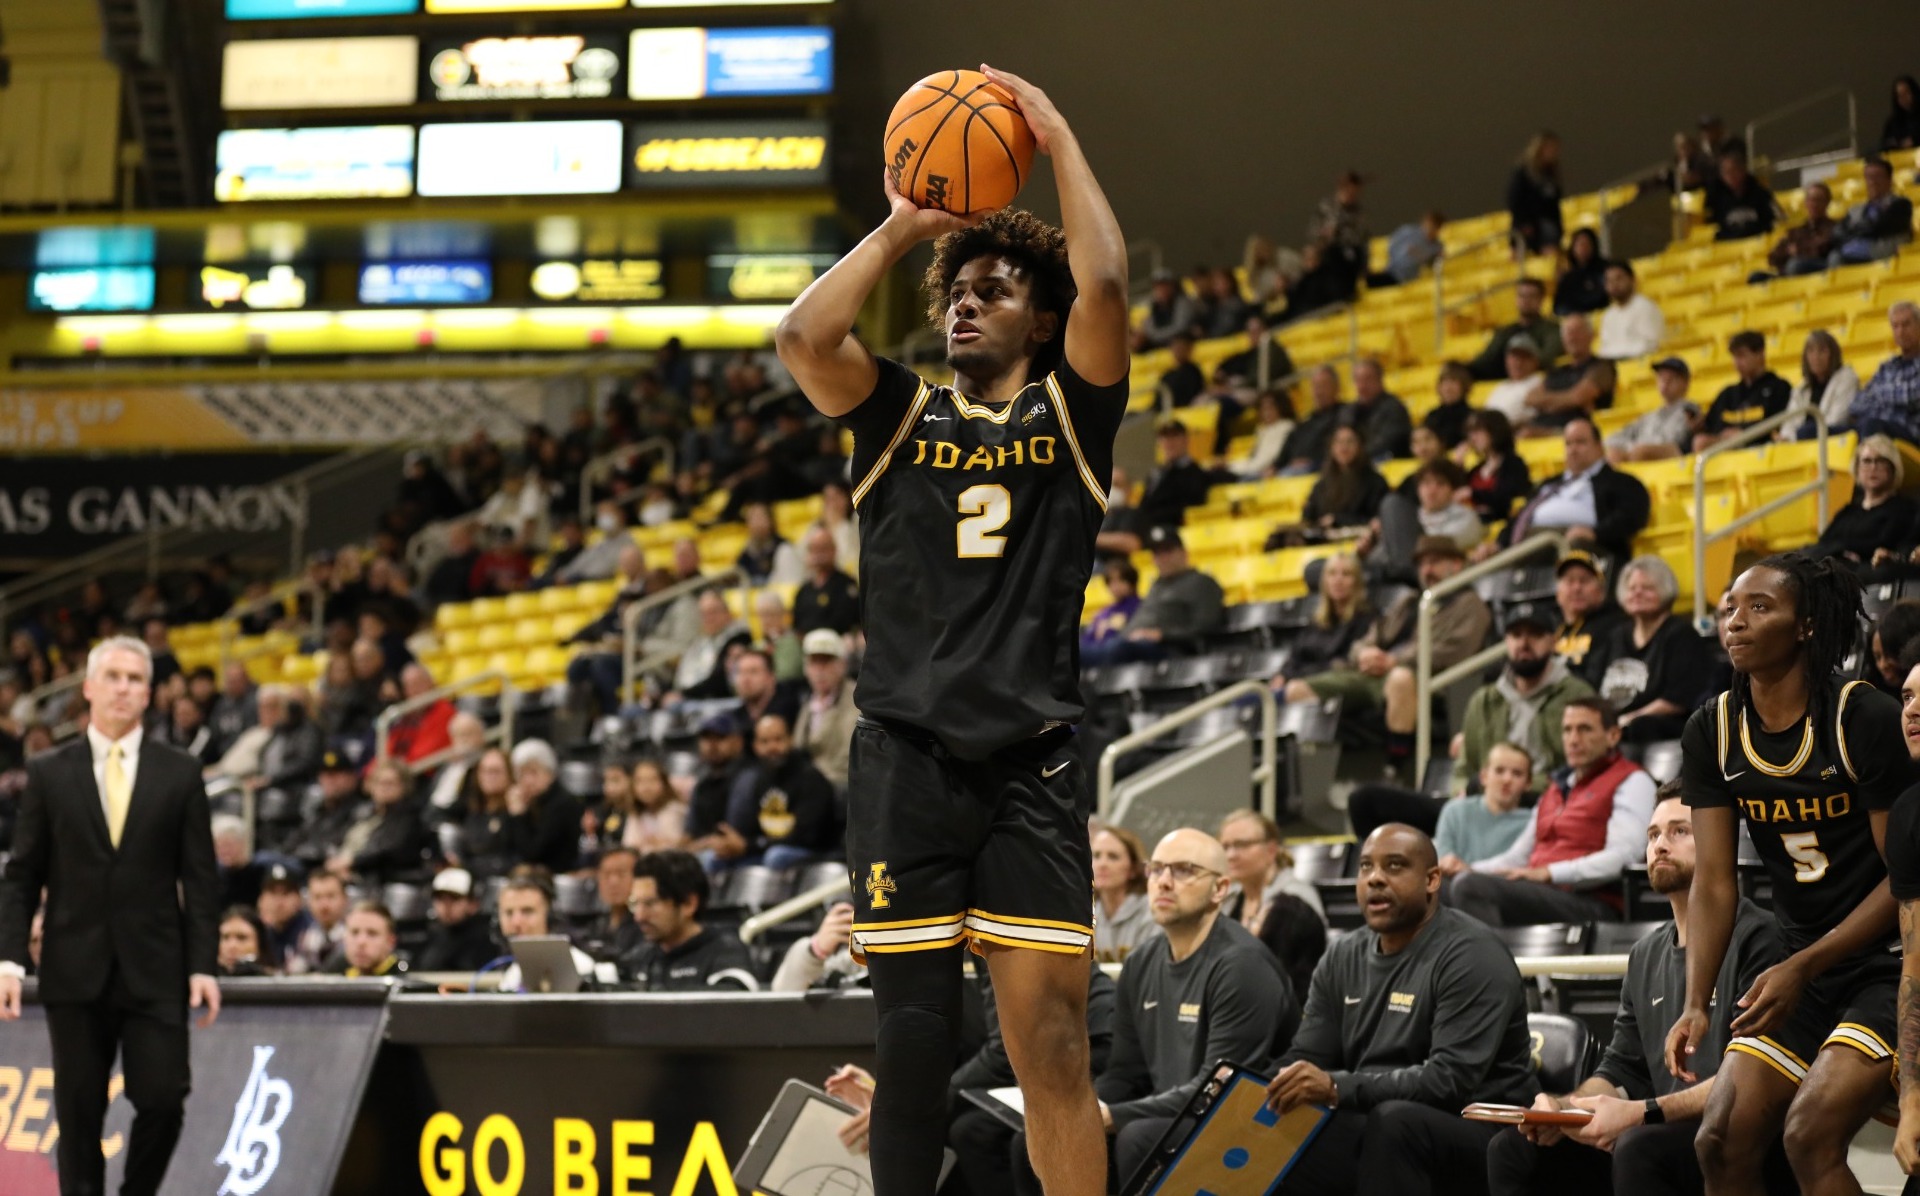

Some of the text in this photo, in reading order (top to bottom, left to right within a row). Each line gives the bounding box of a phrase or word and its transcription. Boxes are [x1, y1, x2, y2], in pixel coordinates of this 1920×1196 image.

[912, 436, 1056, 471] IDAHO
[67, 484, 308, 535] GANNON
[956, 484, 1012, 558] 2
[1780, 831, 1829, 883] 5
[419, 1111, 742, 1196] GO BEA
